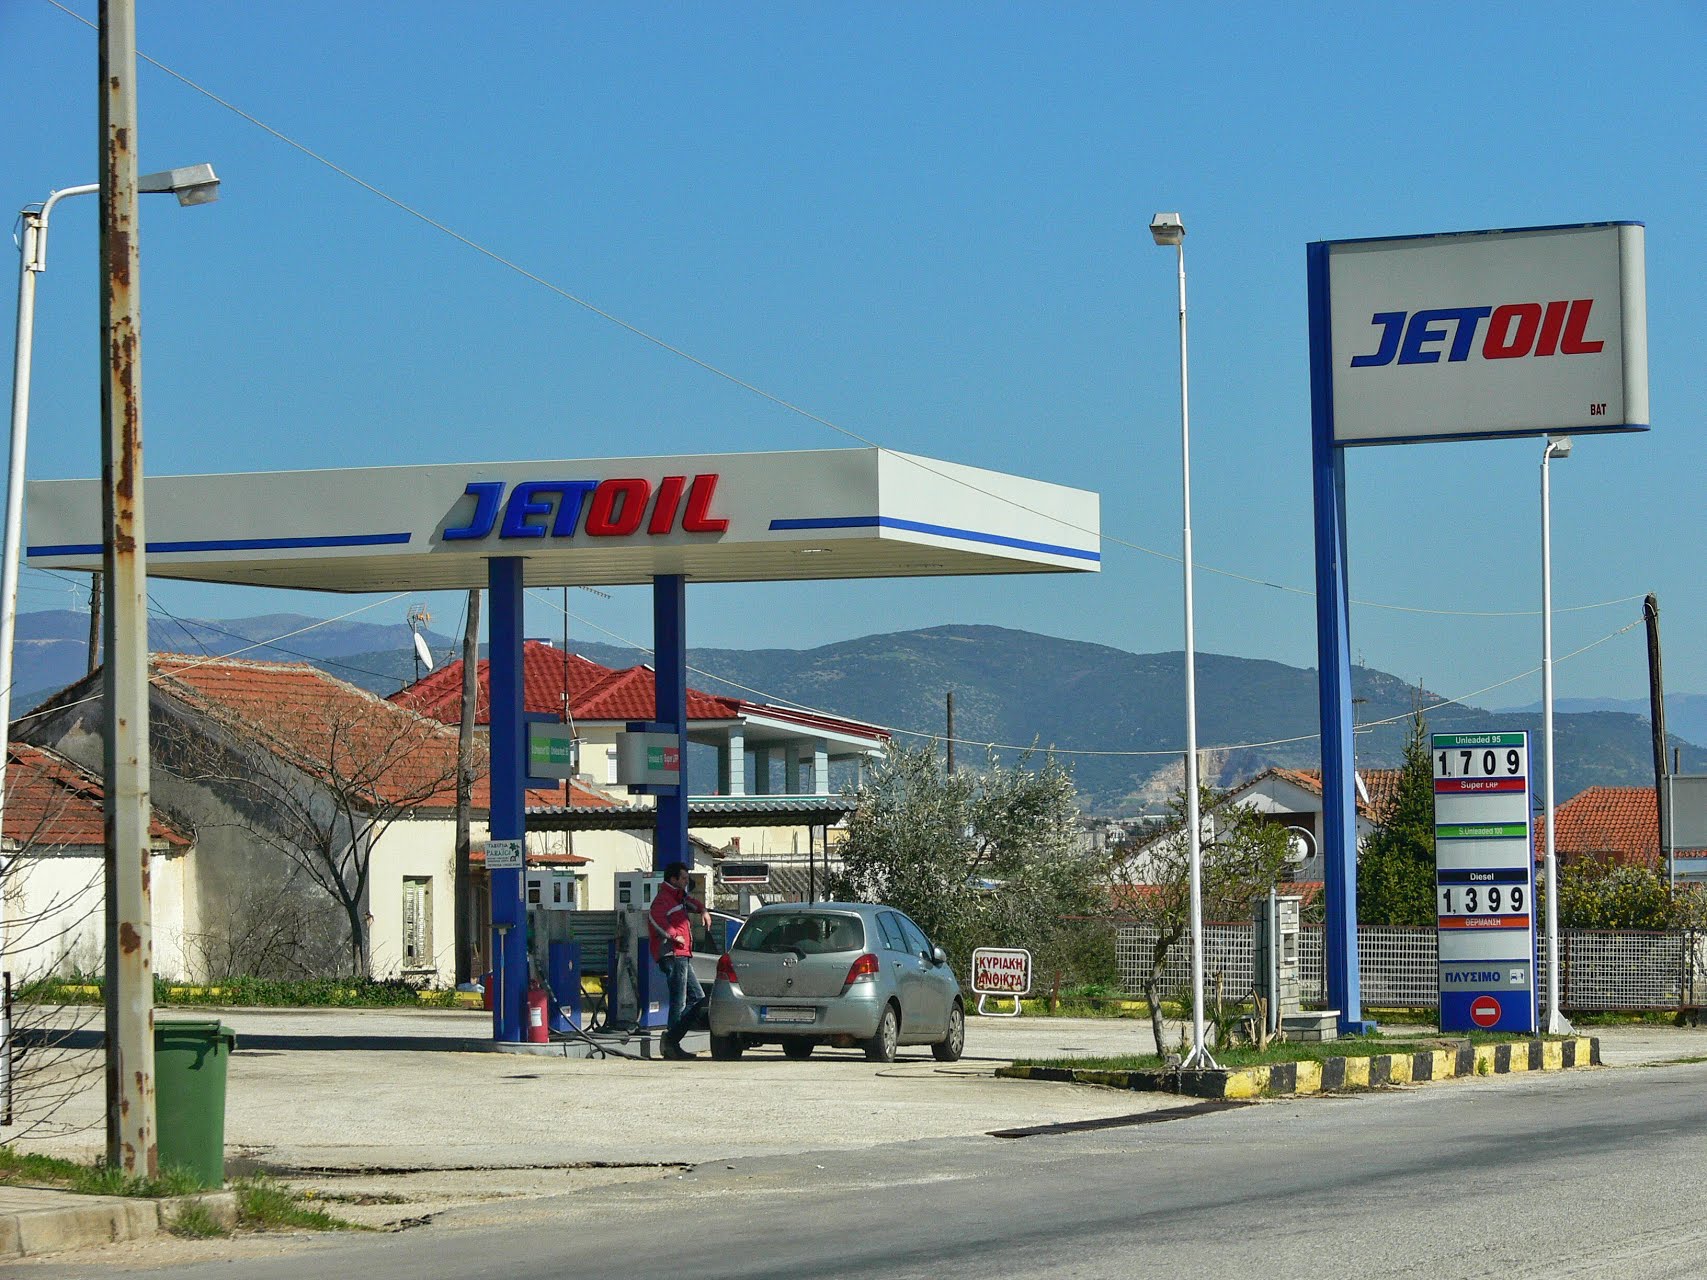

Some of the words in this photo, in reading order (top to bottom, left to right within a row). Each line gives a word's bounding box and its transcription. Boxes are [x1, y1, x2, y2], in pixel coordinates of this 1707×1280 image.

[1350, 299, 1605, 368] JETOIL
[442, 473, 730, 541] JETOIL
[1455, 736, 1491, 744] Unleaded
[1491, 735, 1502, 743] 95
[1460, 781, 1484, 790] Super
[1469, 872, 1495, 881] Diesel
[1465, 918, 1502, 926] ΘΕΡΜΑΝΣΗ
[979, 956, 1023, 969] ΚΥΡΙΑΚΗ
[1445, 971, 1501, 983] ΠΛΥΣΙΜΟ
